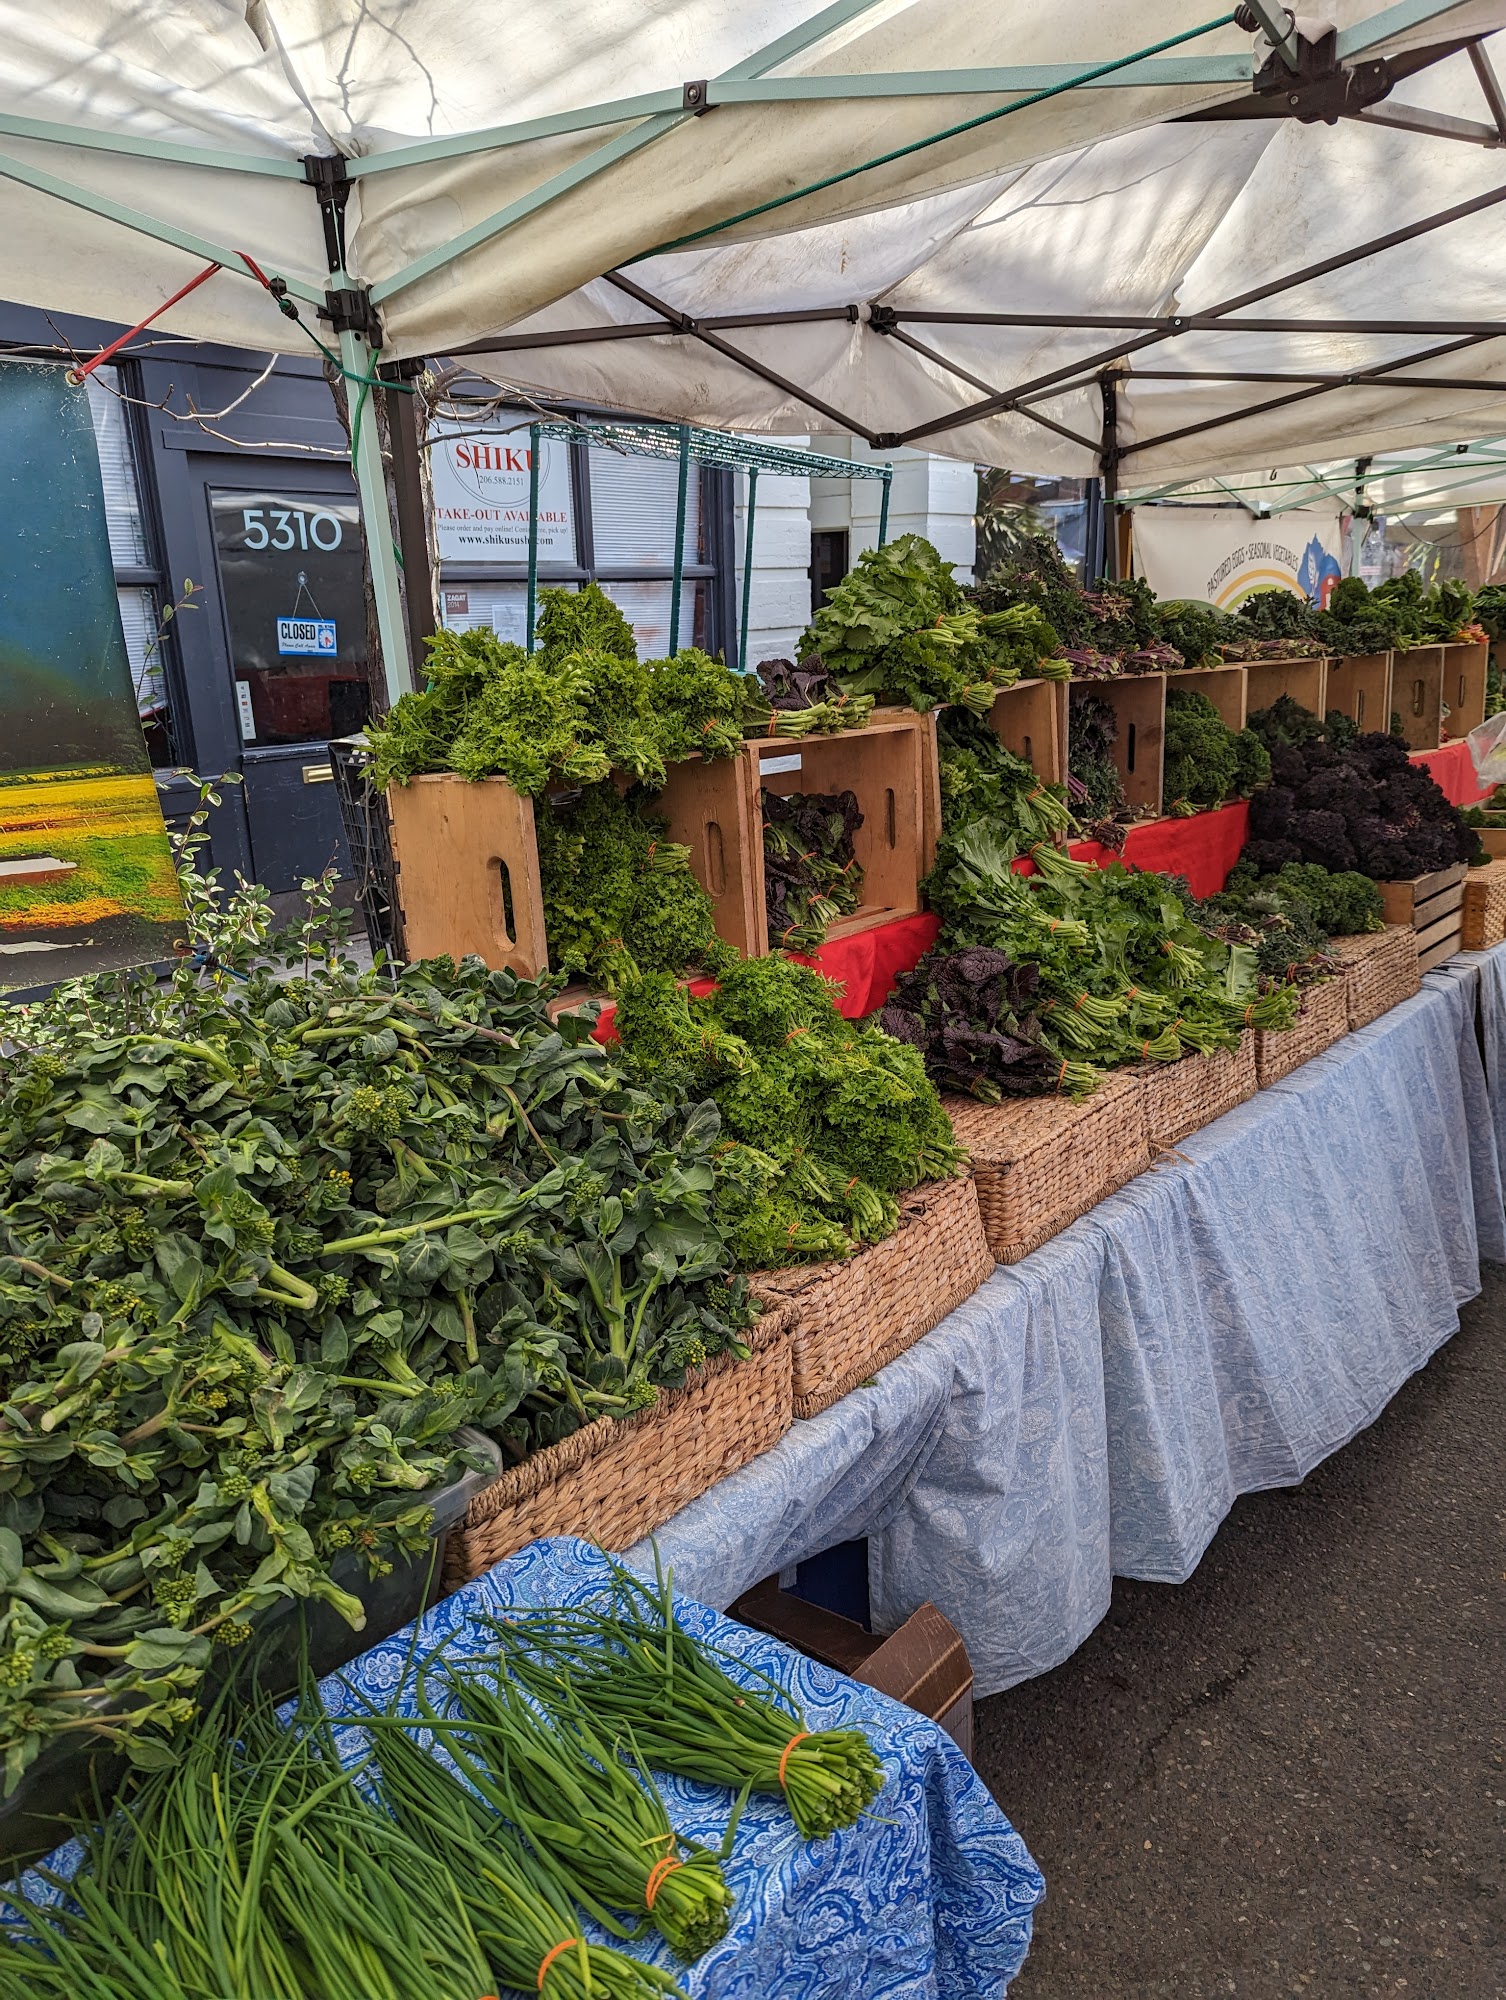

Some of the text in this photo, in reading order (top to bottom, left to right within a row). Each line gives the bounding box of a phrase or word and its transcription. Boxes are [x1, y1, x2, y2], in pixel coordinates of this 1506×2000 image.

[479, 475, 524, 486] 206.588.2151
[435, 507, 567, 523] TAKE-OUT AVAIABLE
[243, 509, 342, 551] 5310
[484, 526, 494, 534] pay
[494, 525, 514, 533] online!
[548, 527, 560, 535] pick
[458, 534, 554, 546] www.shikusushcom
[1206, 542, 1299, 599] PASTURED EGGS SEASONAL VEGETABLES
[446, 594, 467, 602] ZAGAT
[447, 601, 460, 609] 2014
[281, 622, 316, 640] CLOSED
